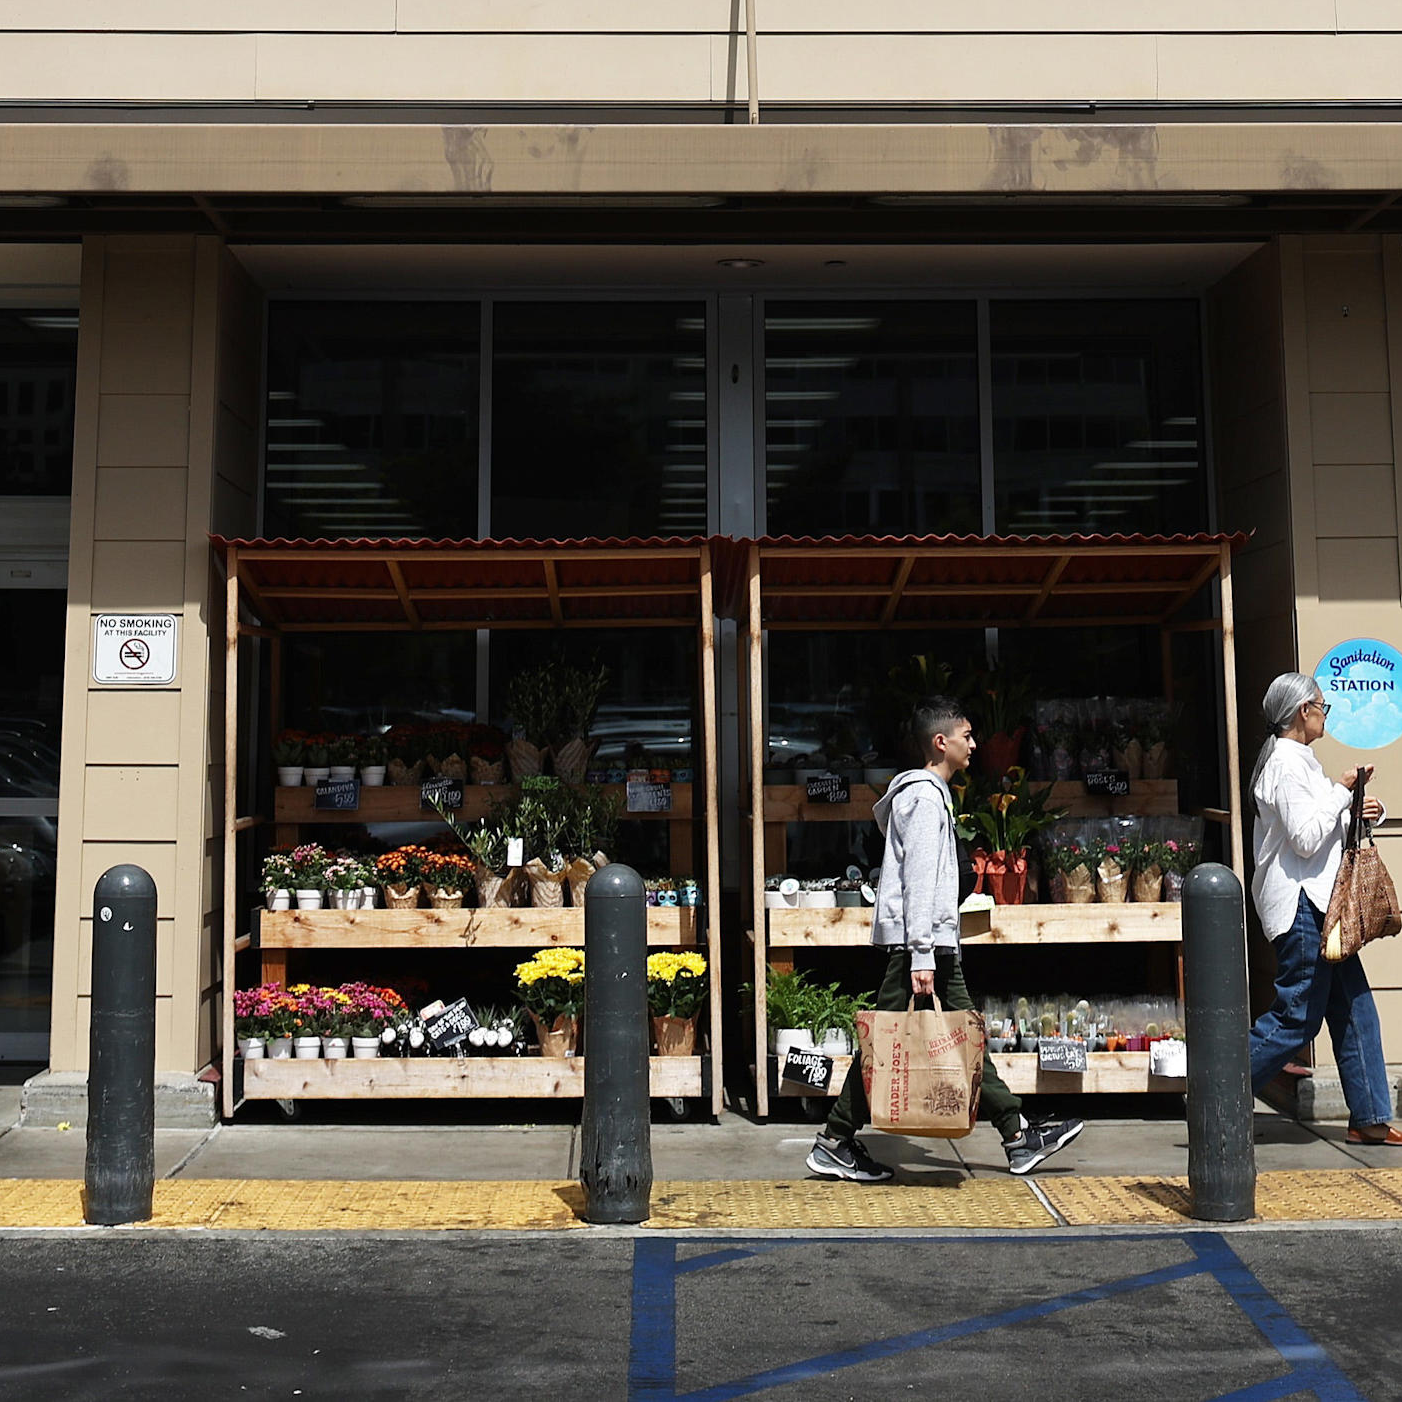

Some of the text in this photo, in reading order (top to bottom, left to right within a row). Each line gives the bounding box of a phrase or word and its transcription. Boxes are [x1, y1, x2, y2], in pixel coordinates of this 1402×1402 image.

[100, 619, 172, 628] NO SMOKING
[1329, 648, 1395, 677] Sanitation
[1330, 679, 1395, 692] STATION
[787, 1052, 826, 1068] FOLIAGE
[890, 1042, 902, 1123] TRADER JOE'S
